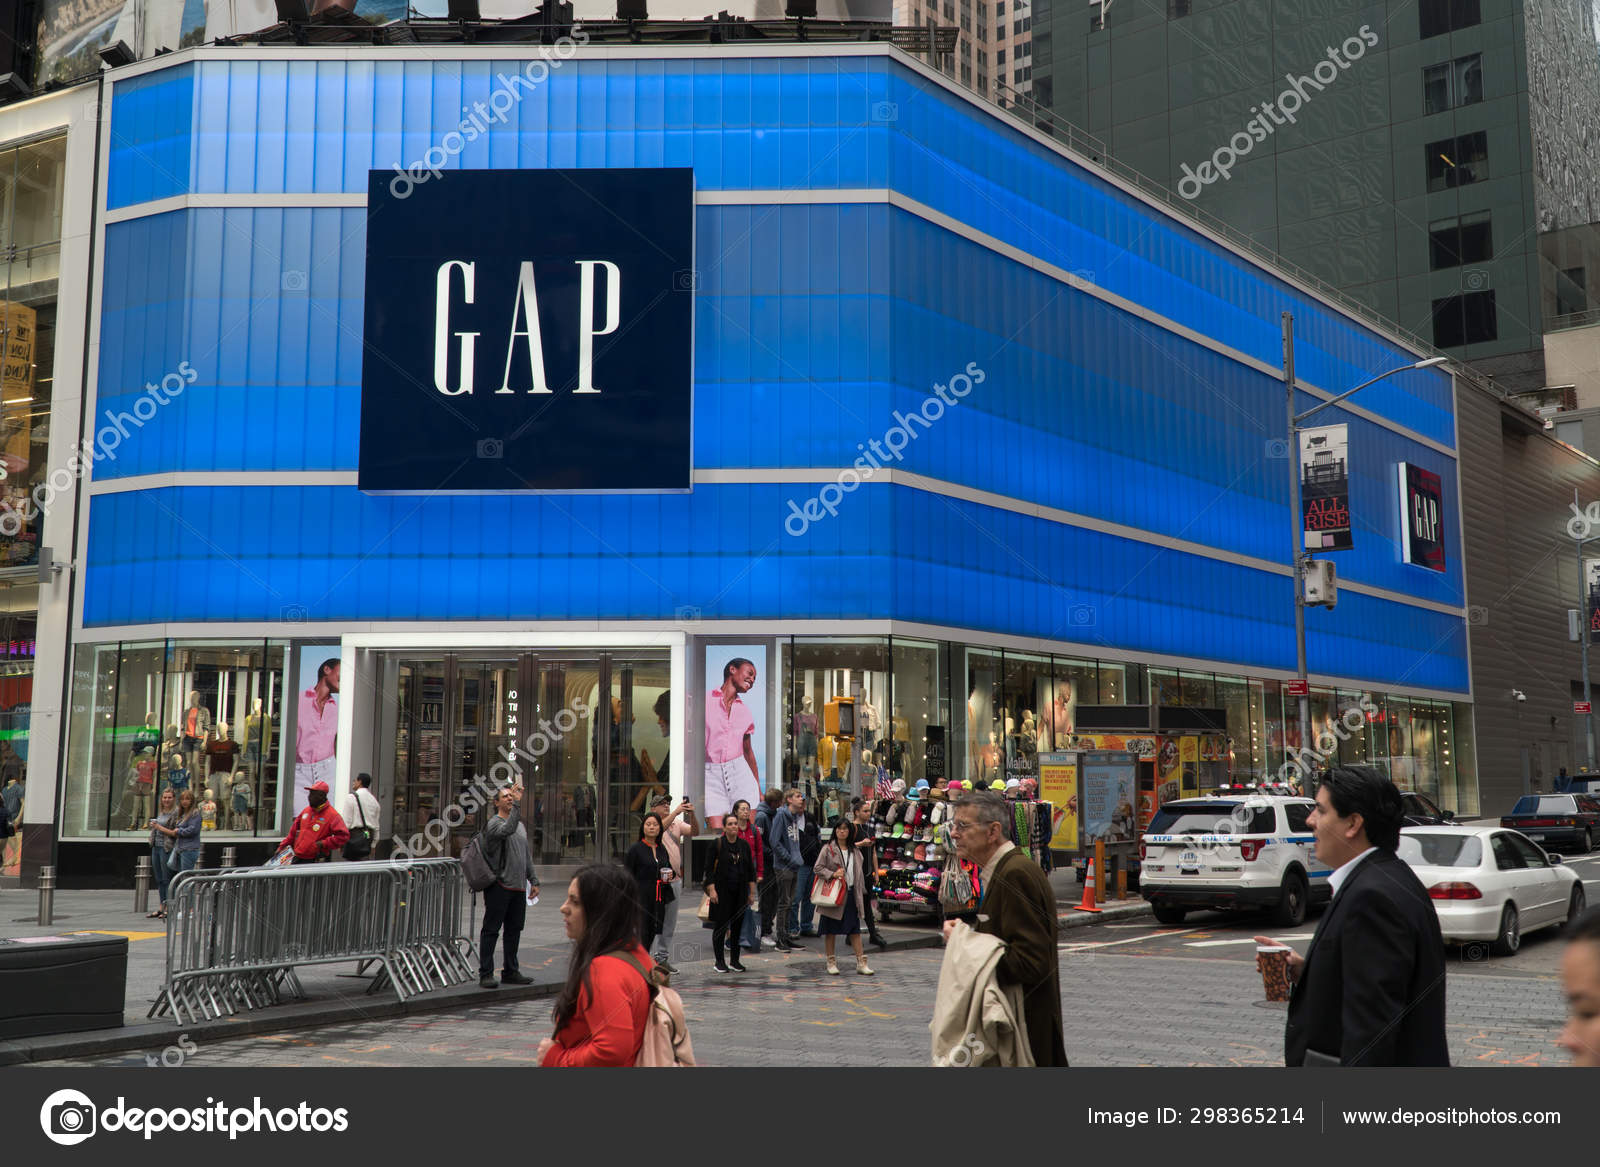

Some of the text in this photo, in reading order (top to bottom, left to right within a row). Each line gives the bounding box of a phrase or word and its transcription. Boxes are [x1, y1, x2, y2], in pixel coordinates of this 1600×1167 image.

[435, 260, 621, 396] GAP
[1308, 497, 1345, 515] ALL
[1304, 511, 1350, 530] RISE
[1414, 493, 1437, 542] GAP
[1006, 756, 1033, 770] Malibu
